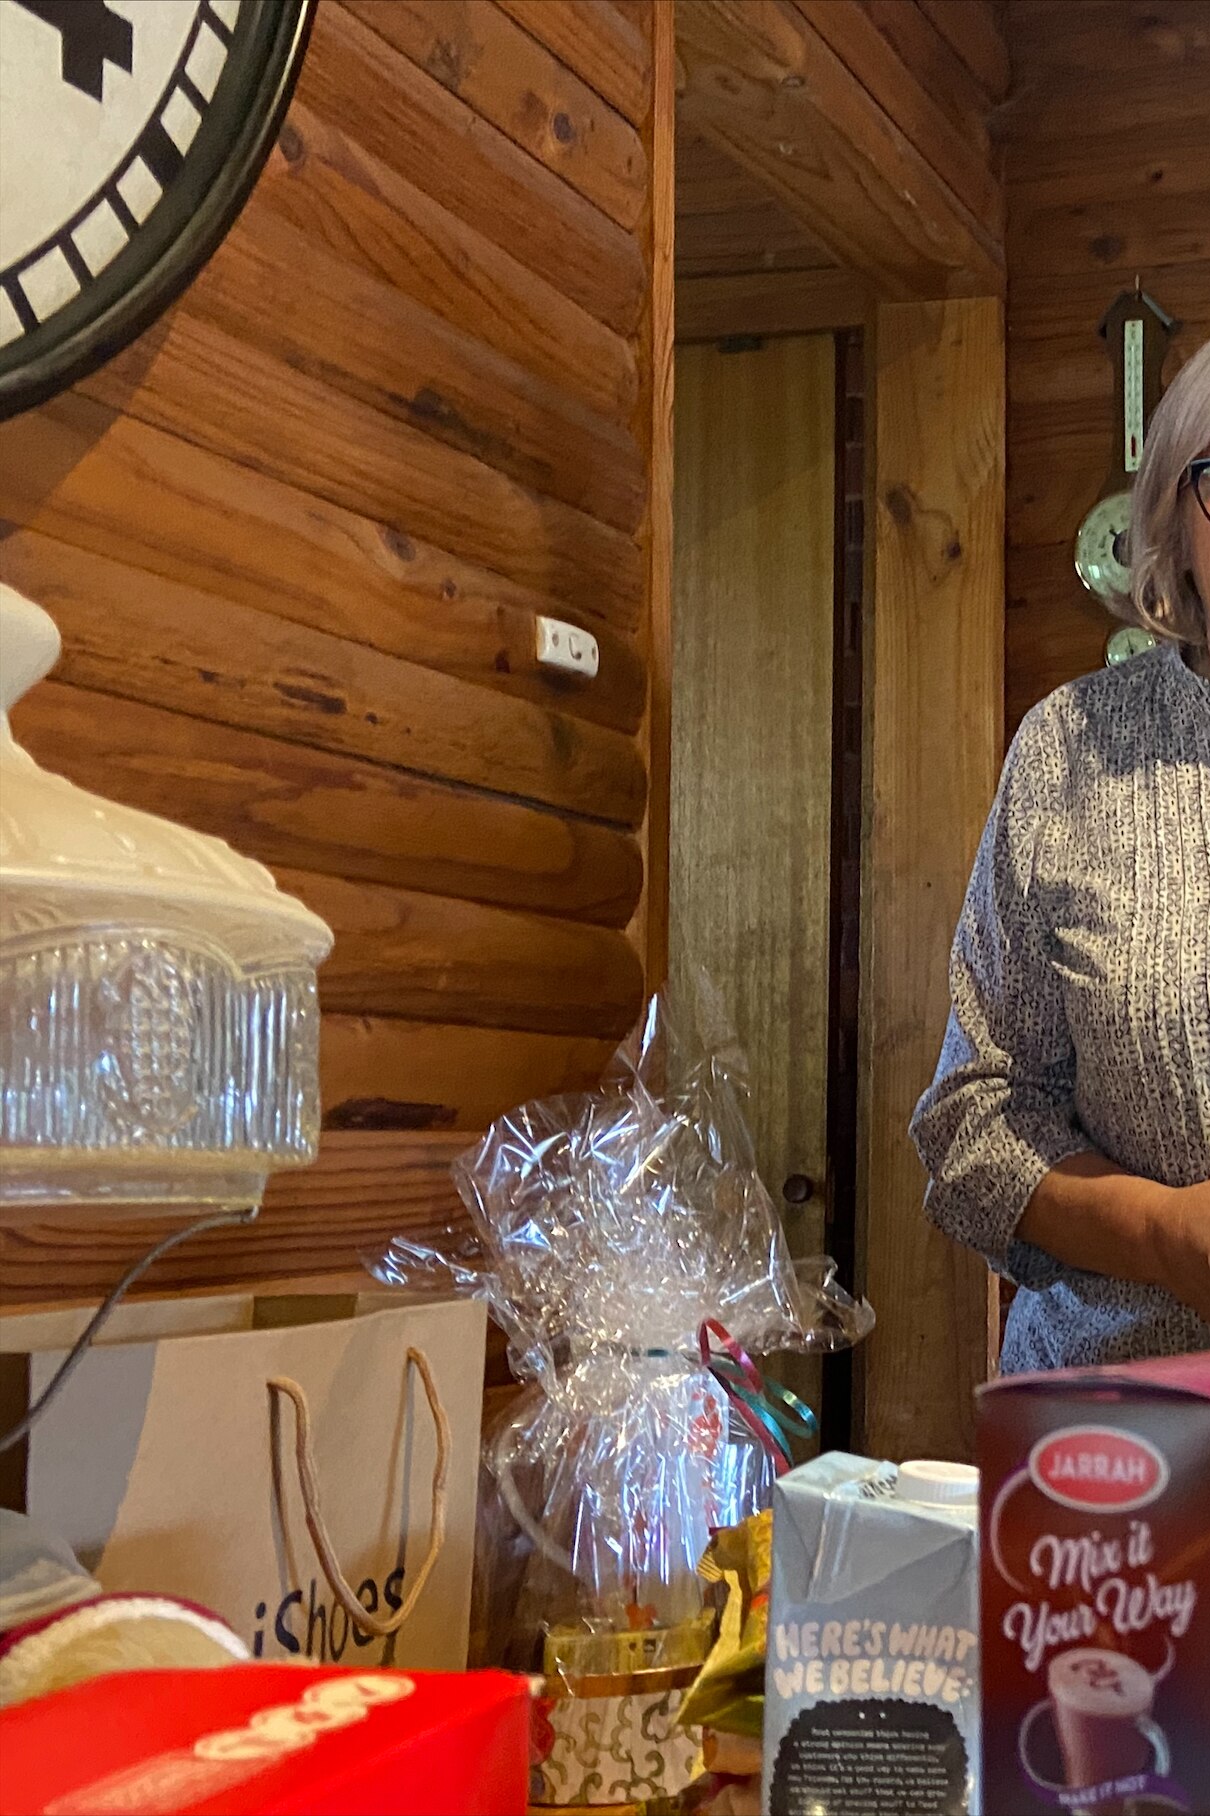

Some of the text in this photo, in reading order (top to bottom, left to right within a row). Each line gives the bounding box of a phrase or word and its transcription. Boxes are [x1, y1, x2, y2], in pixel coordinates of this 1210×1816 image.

[1047, 1451, 1148, 1486] JARRAH
[1029, 1520, 1153, 1591] Mix it
[775, 1618, 978, 1662] HERE'S WHAT
[1002, 1577, 1197, 1672] Your Way
[773, 1658, 974, 1704] WE BELIEVE:
